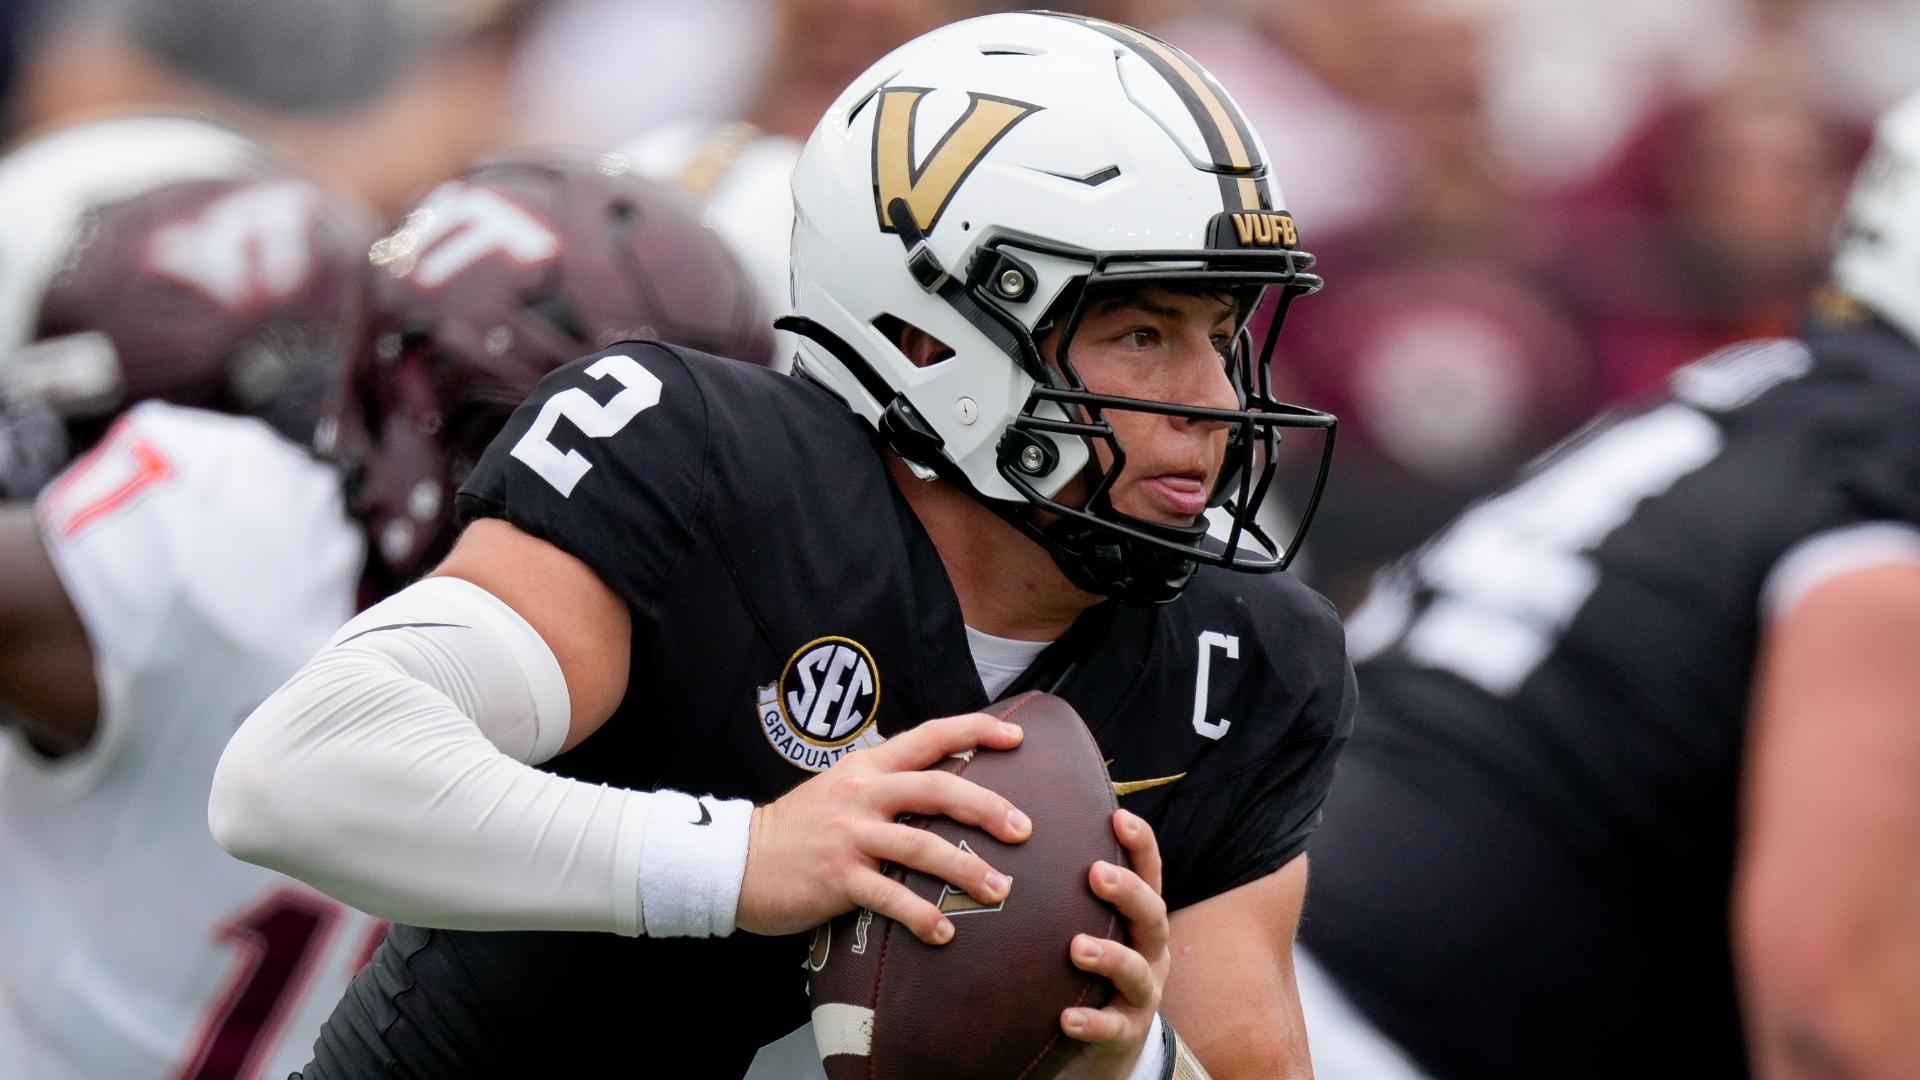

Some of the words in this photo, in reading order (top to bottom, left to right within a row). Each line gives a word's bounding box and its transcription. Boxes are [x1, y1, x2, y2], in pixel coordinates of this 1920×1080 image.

[871, 86, 1047, 237] V
[1232, 213, 1297, 247] VUFB
[510, 355, 663, 499] 2
[787, 645, 873, 738] SEC
[1192, 630, 1239, 740] C
